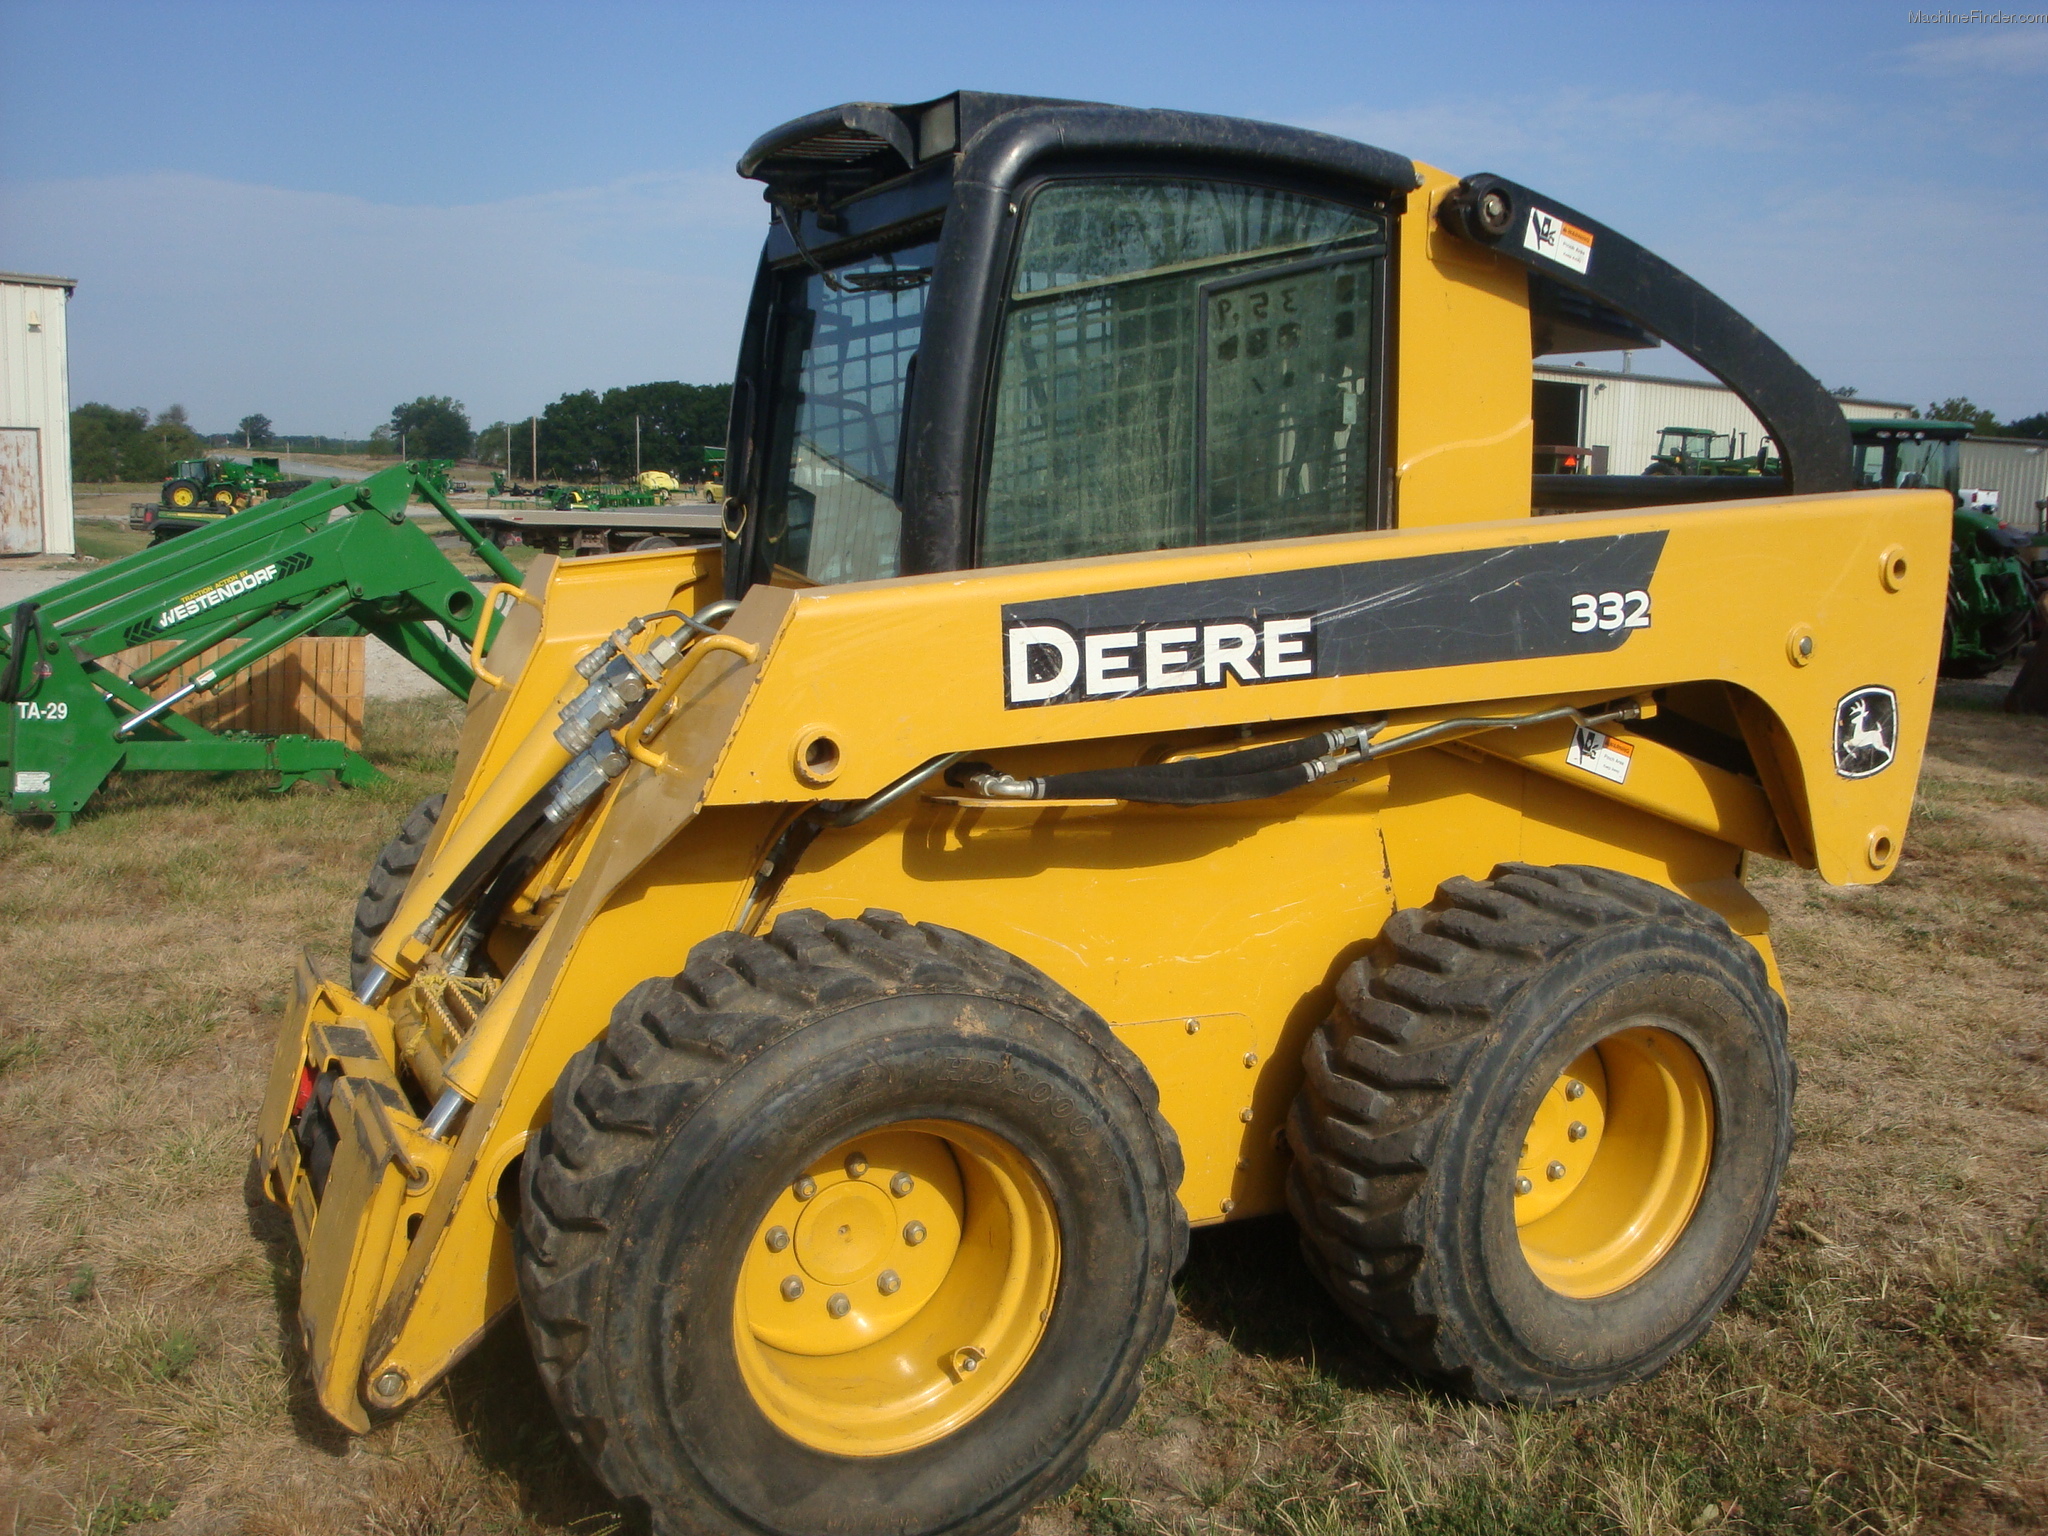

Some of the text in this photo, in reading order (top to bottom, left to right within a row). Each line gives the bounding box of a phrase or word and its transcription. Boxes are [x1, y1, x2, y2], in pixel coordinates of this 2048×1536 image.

[158, 564, 278, 628] WESTENDORF
[180, 569, 249, 603] TRACTION ACTION BY
[1571, 590, 1650, 632] 332
[1008, 617, 1312, 703] DEERE
[17, 701, 68, 720] TA-29
